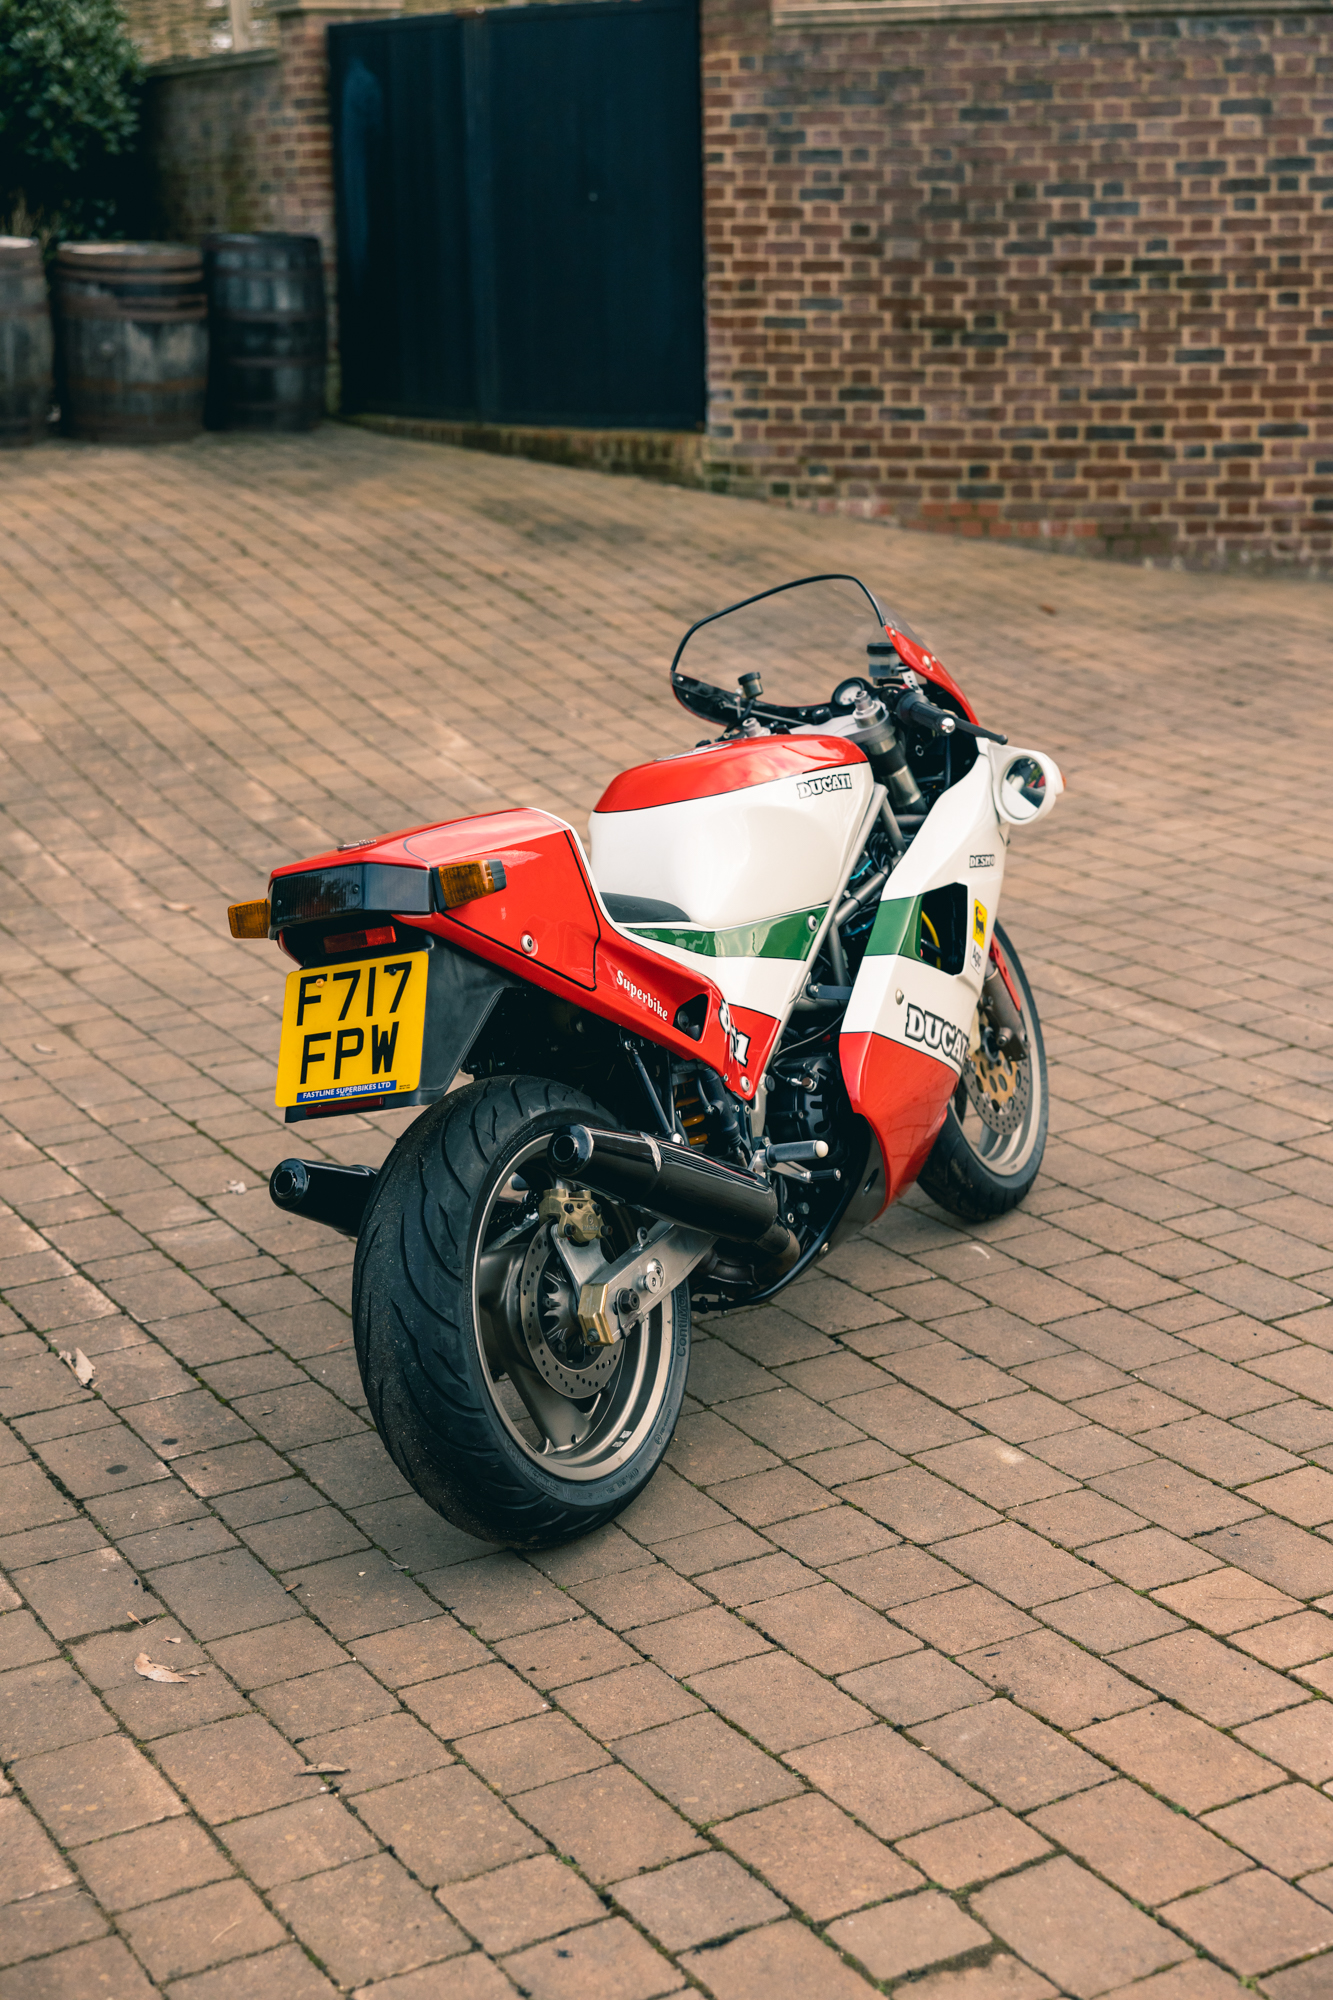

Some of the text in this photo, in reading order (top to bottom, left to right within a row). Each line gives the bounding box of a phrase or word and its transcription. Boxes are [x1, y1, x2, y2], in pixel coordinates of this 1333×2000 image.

[796, 773, 852, 799] DUCATI
[969, 854, 995, 868] DESMO
[297, 961, 412, 1026] F717
[616, 969, 668, 1021] Superbike
[300, 1021, 399, 1084] FPW
[303, 1087, 335, 1098] FASTLINE
[336, 1083, 376, 1094] SUPERBIKES
[378, 1081, 391, 1089] LTD
